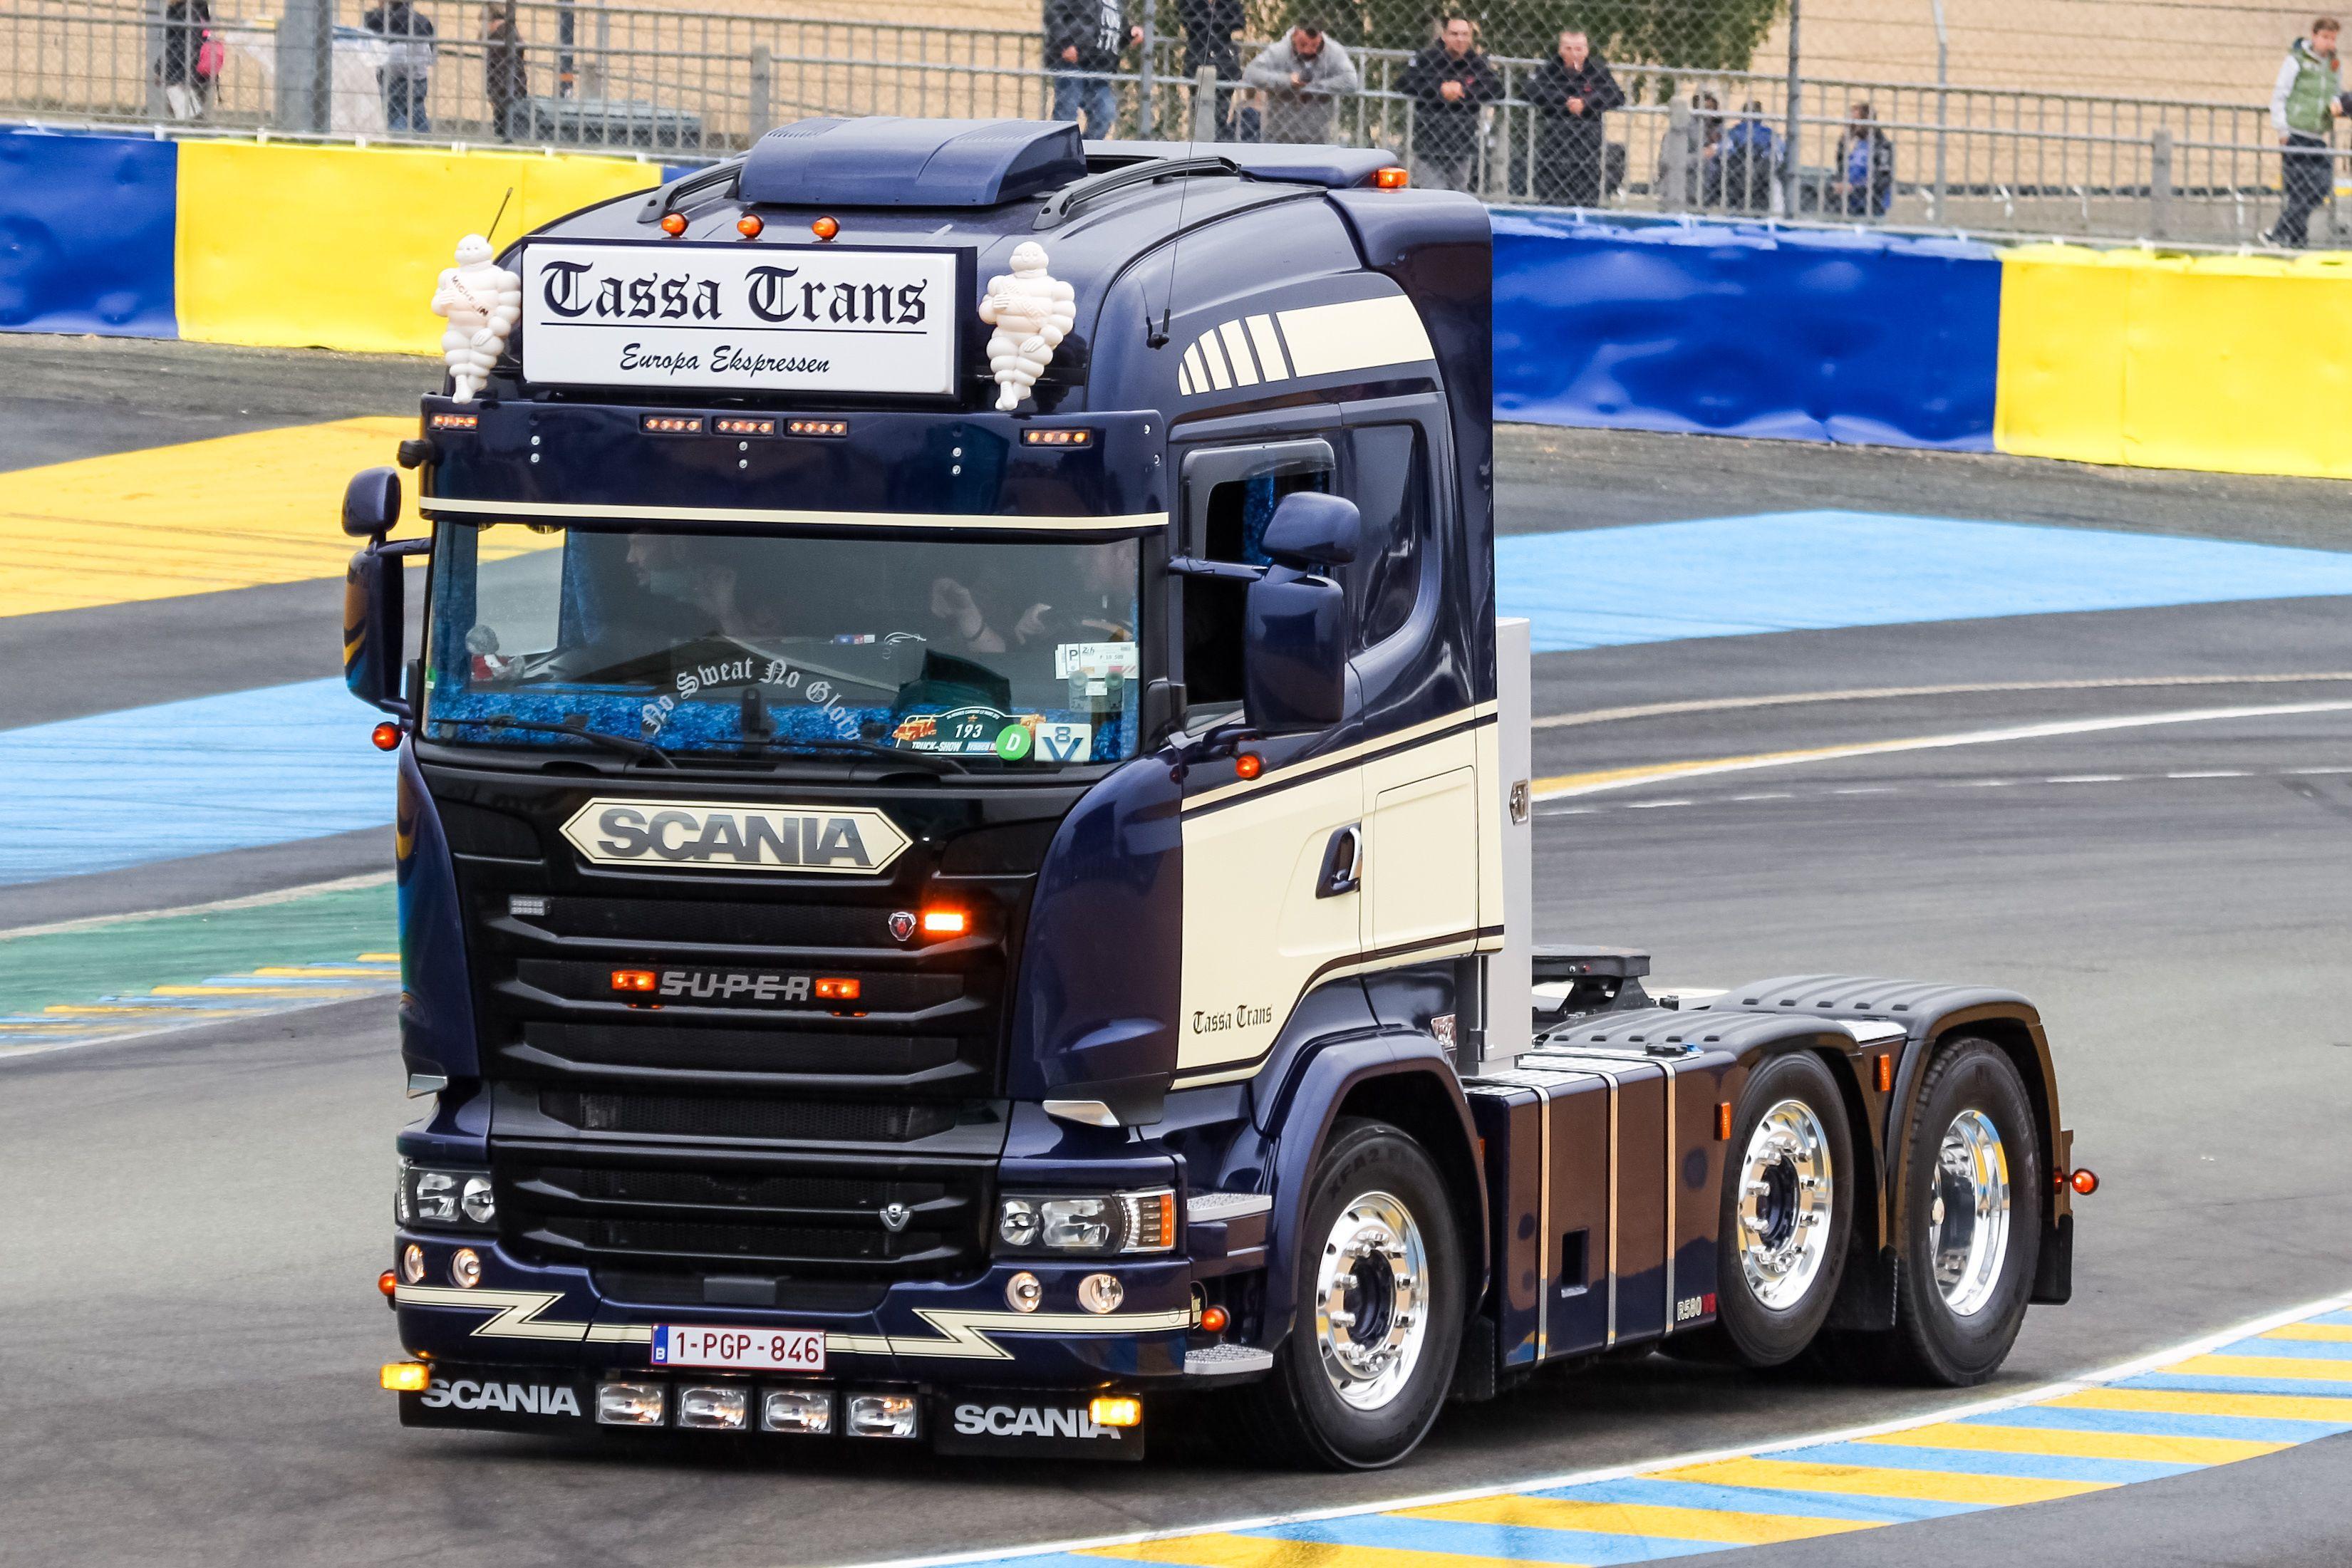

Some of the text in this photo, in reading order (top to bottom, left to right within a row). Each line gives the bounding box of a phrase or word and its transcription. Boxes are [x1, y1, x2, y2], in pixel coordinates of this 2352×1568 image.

[540, 261, 928, 325] Tassa Trans
[619, 343, 831, 378] Europa Ekspressen
[642, 657, 861, 741] No Sweat No Glory
[955, 723, 983, 739] 193
[1005, 733, 1021, 752] D
[596, 806, 874, 867] SCANIA
[658, 970, 811, 1002] SUPER
[1192, 1004, 1273, 1035] Tassa Trans
[655, 1331, 819, 1364] B 1-PGP-846
[421, 1378, 581, 1417] SCANIA
